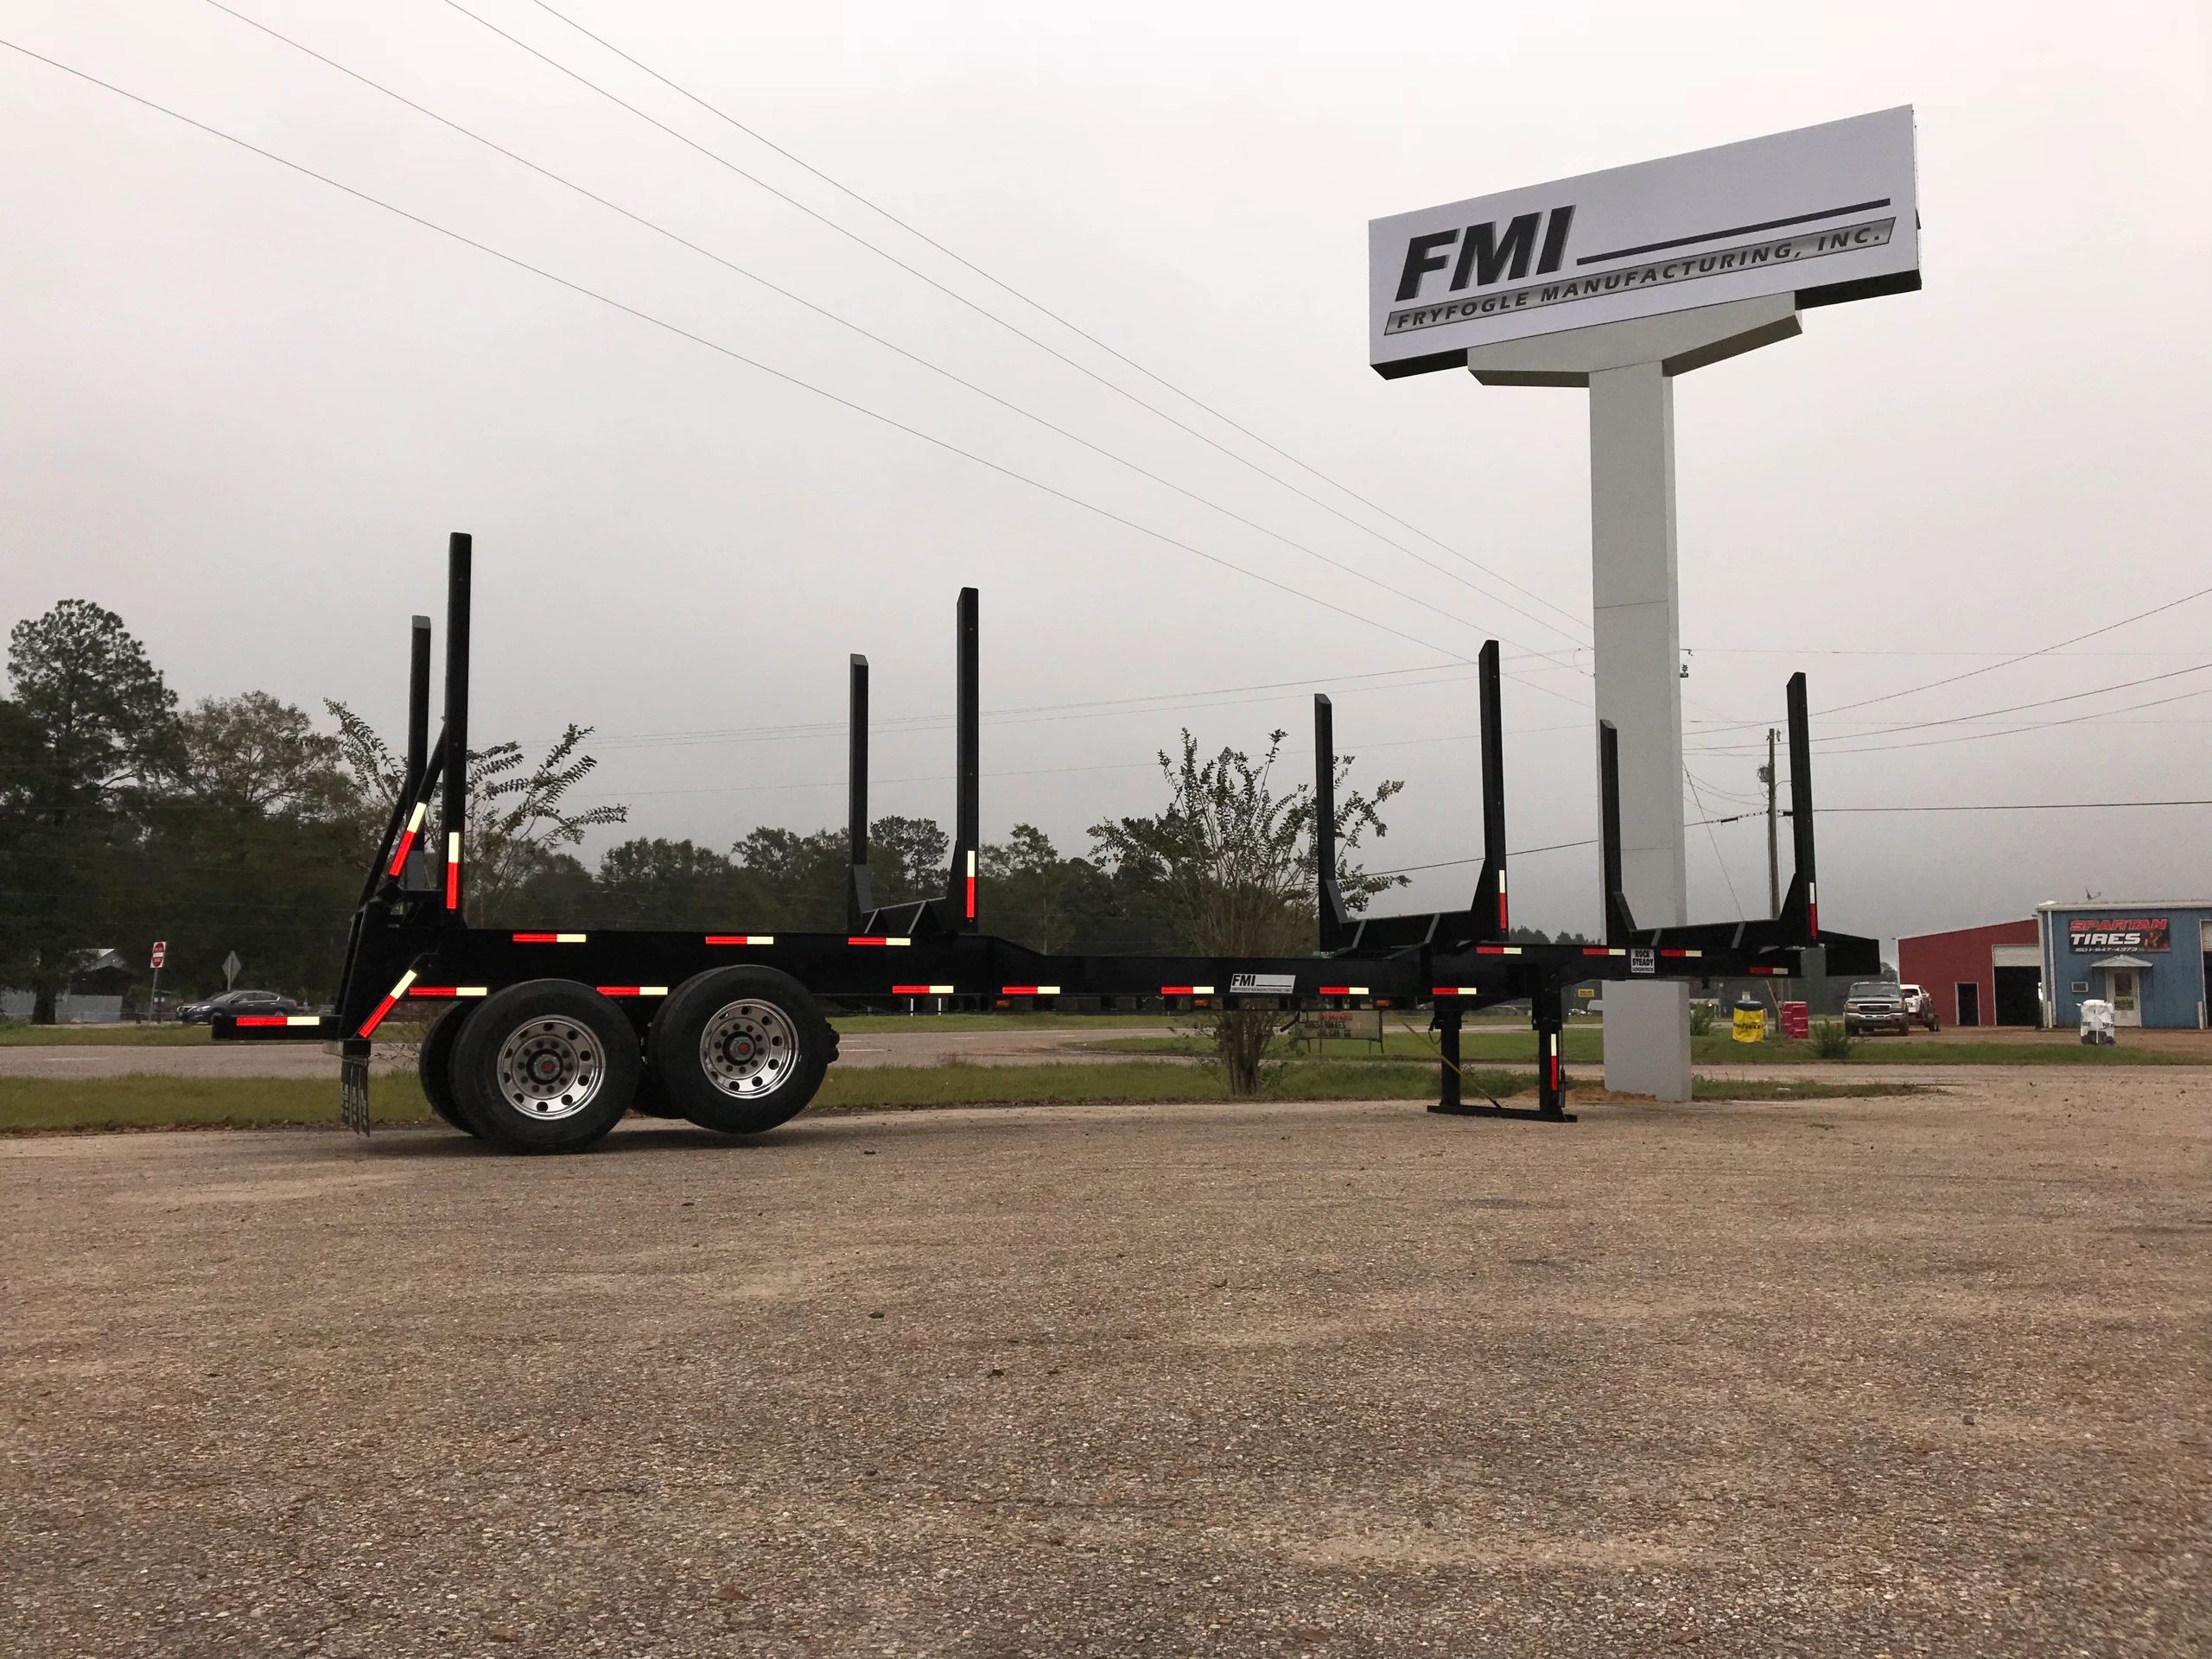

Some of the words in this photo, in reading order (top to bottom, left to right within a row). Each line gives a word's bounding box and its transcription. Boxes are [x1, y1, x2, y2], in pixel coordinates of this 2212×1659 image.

[1395, 205, 1576, 302] FMI
[1397, 291, 1529, 328] FRYFOGLE
[1541, 243, 1801, 302] MANUFACTURING,
[1817, 227, 1880, 251] INC.
[2069, 918, 2167, 931] SPARTAN
[2070, 933, 2140, 944] TIRES
[1232, 975, 1255, 987] FMI
